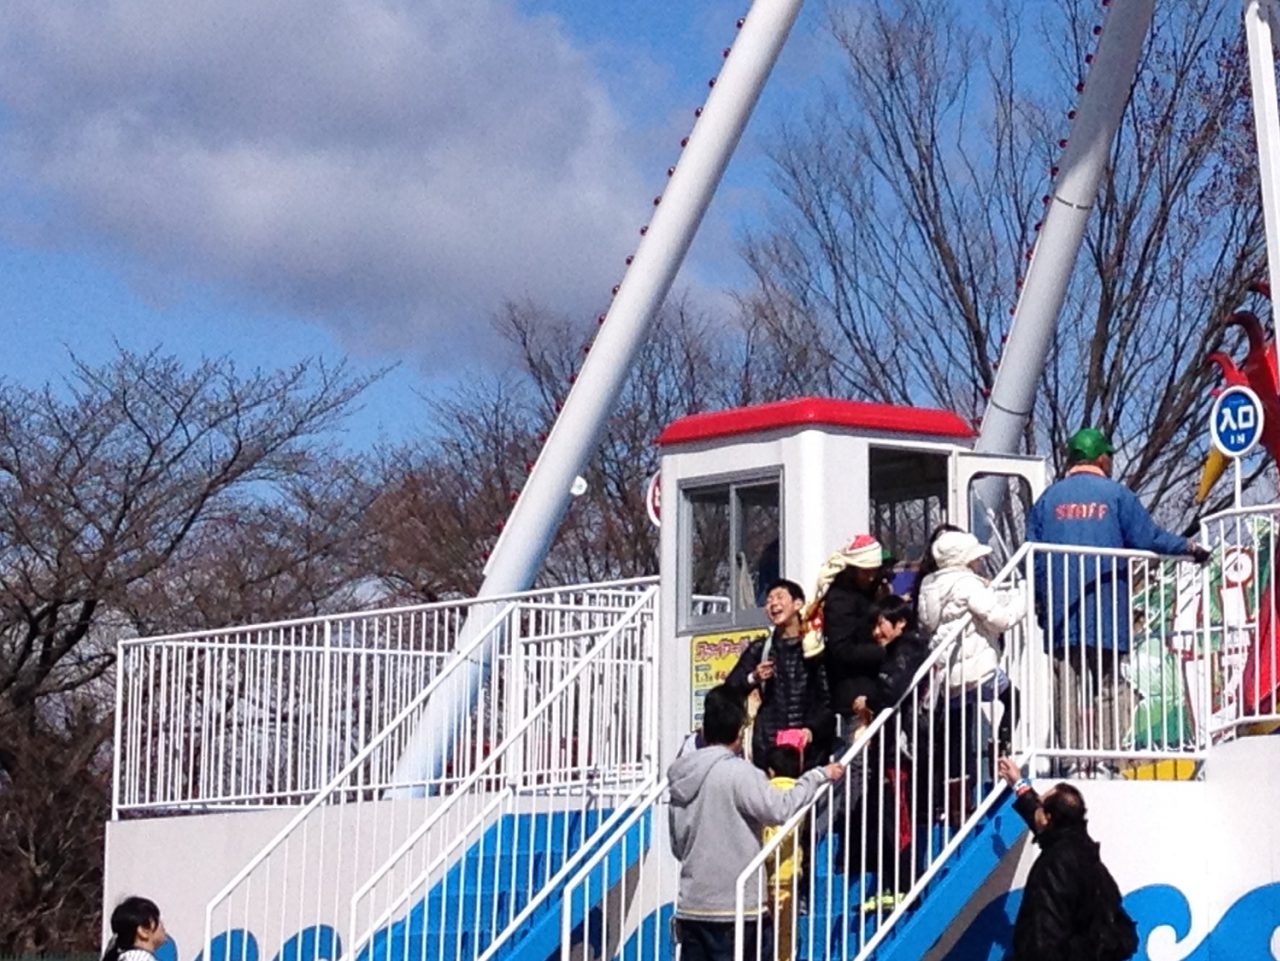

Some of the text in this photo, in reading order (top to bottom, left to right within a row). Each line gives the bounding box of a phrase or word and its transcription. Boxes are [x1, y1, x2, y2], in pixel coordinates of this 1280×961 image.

[1220, 405, 1254, 432] 入口
[1230, 433, 1246, 445] IN
[1055, 502, 1108, 520] STAFF
